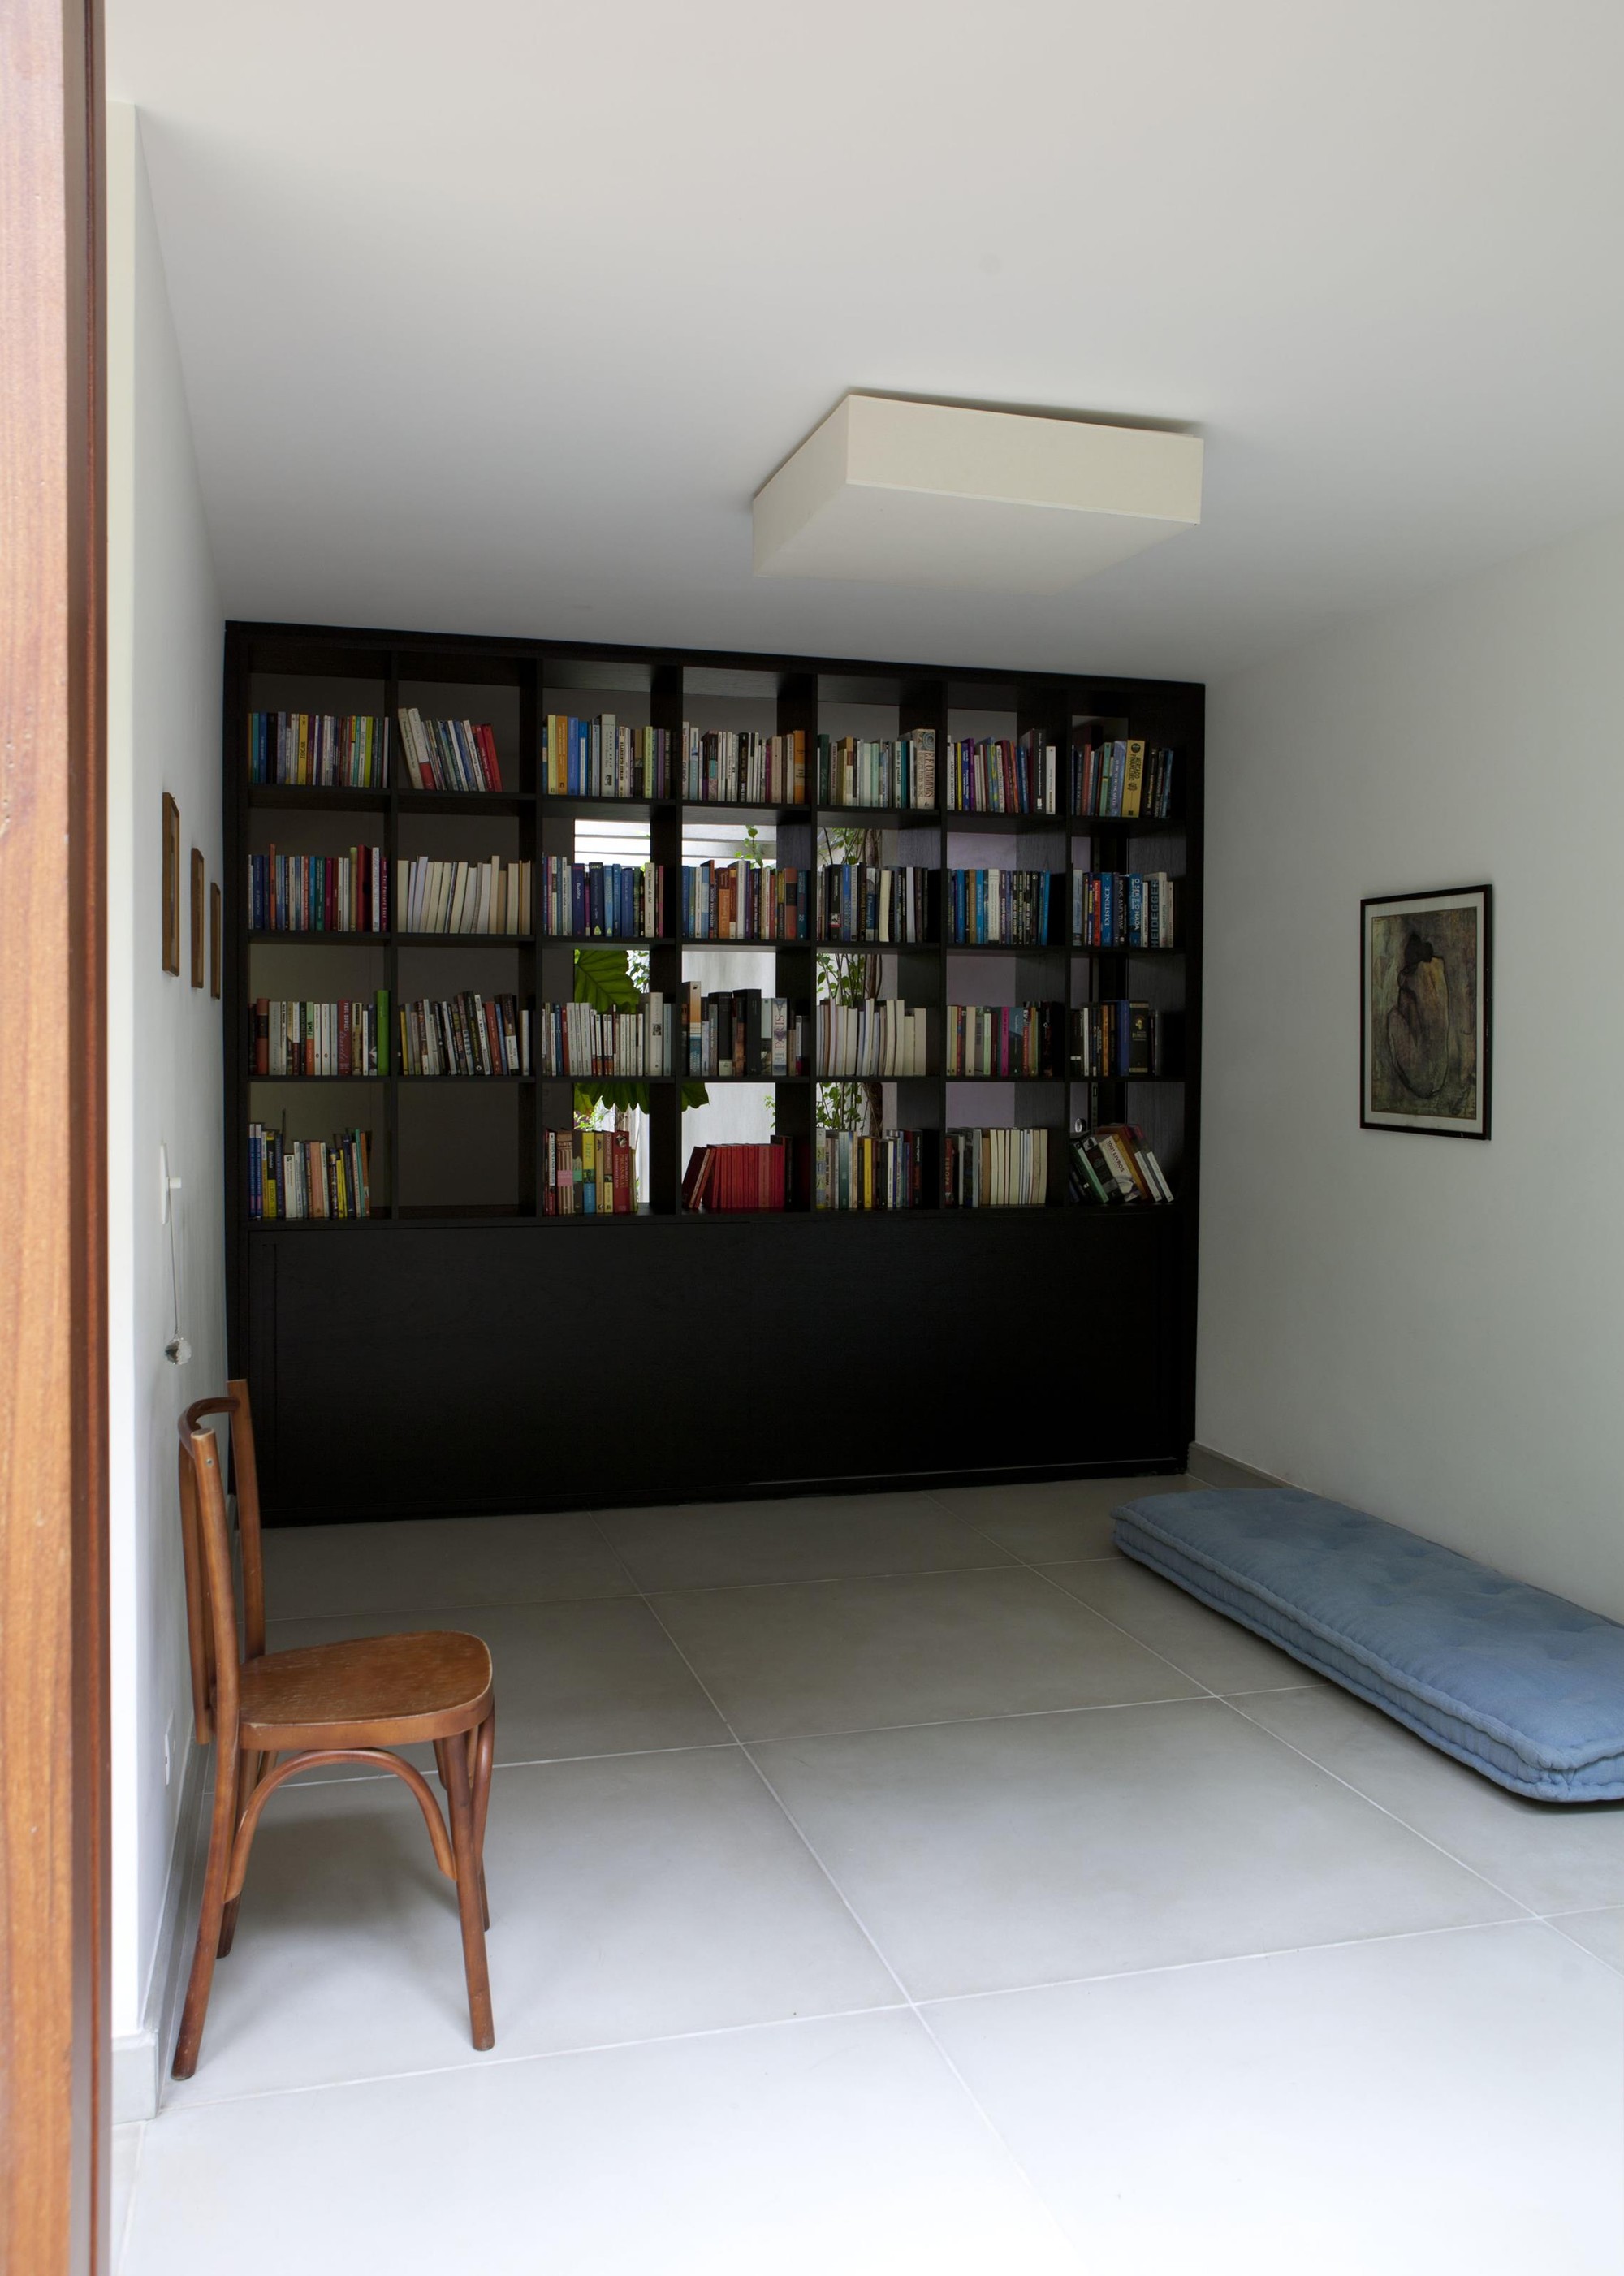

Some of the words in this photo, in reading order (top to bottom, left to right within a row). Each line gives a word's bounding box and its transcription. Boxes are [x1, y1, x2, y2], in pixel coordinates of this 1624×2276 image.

[1128, 754, 1137, 780] FINANCEIRO
[774, 1014, 784, 1048] PARIS
[1112, 1151, 1125, 1173] LIVROS
